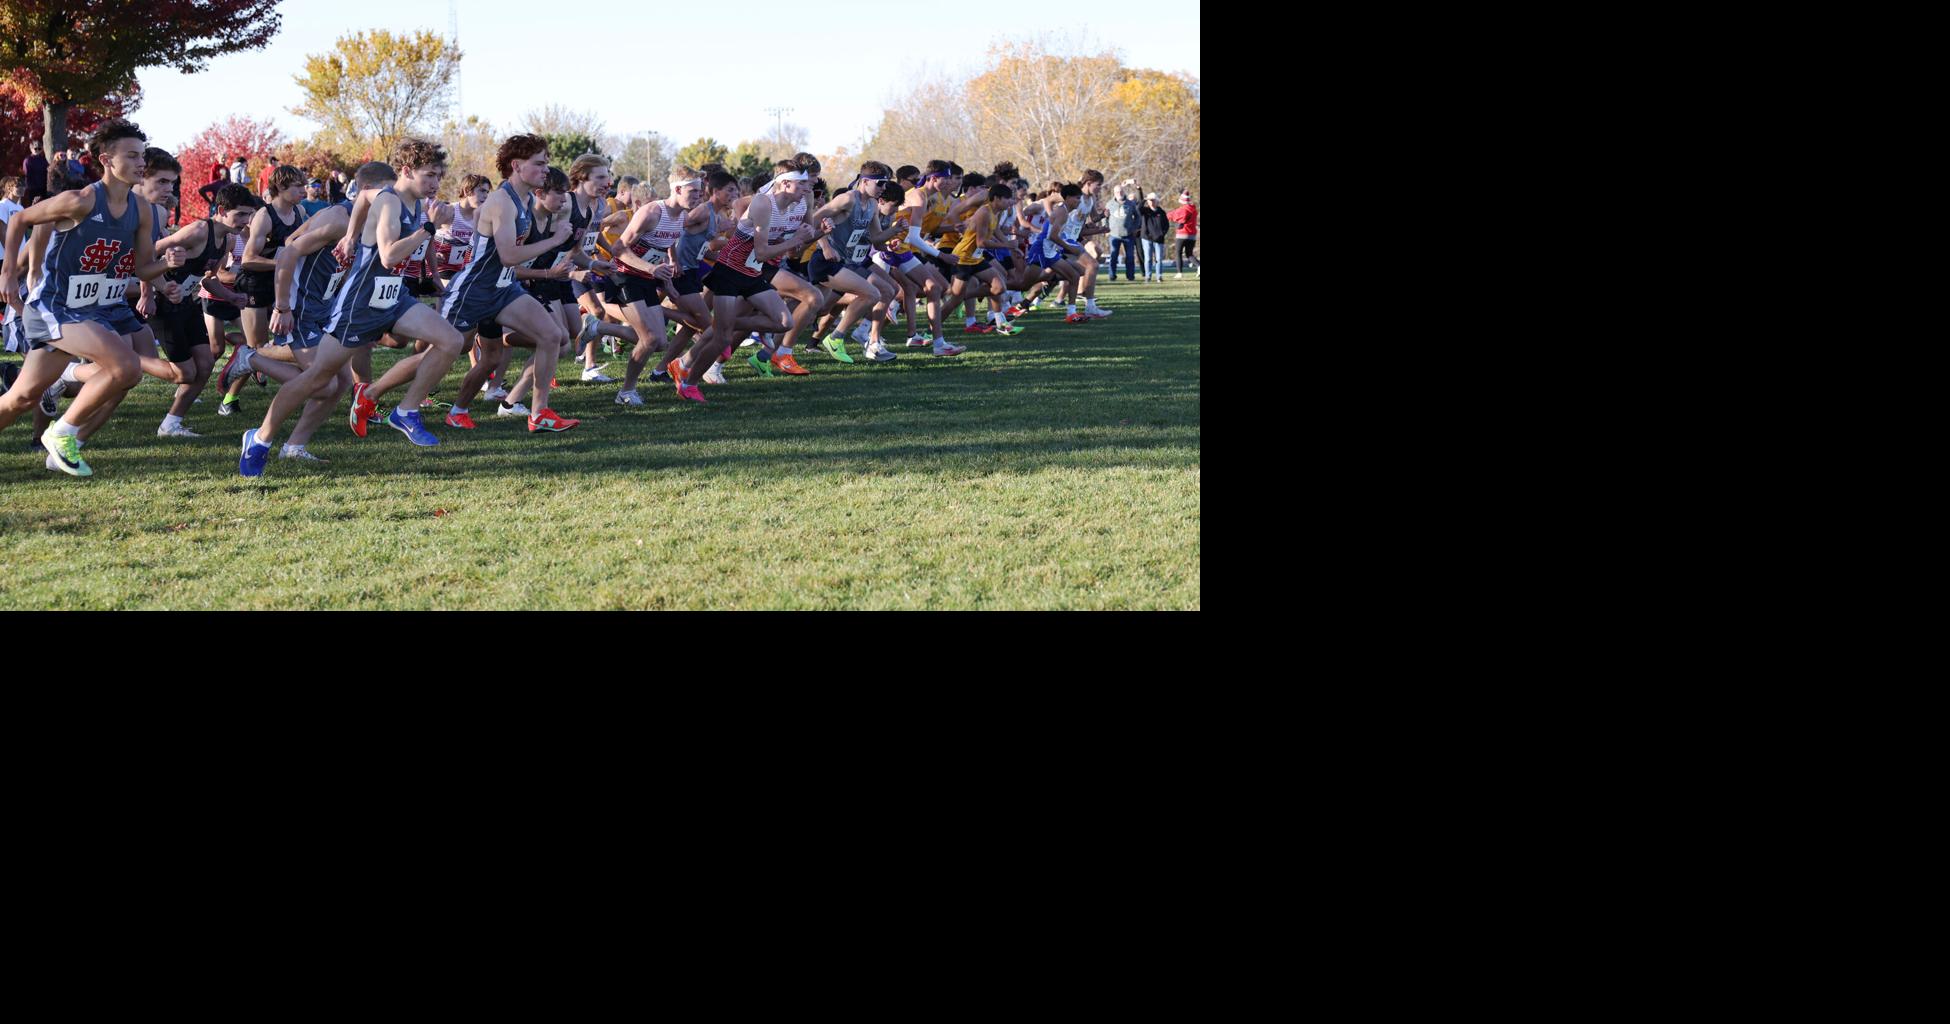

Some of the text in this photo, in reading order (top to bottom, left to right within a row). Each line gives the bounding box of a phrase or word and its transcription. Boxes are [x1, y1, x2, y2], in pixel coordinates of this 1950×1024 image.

[75, 282, 99, 300] 109
[105, 284, 126, 300] 112
[378, 284, 399, 300] 106
